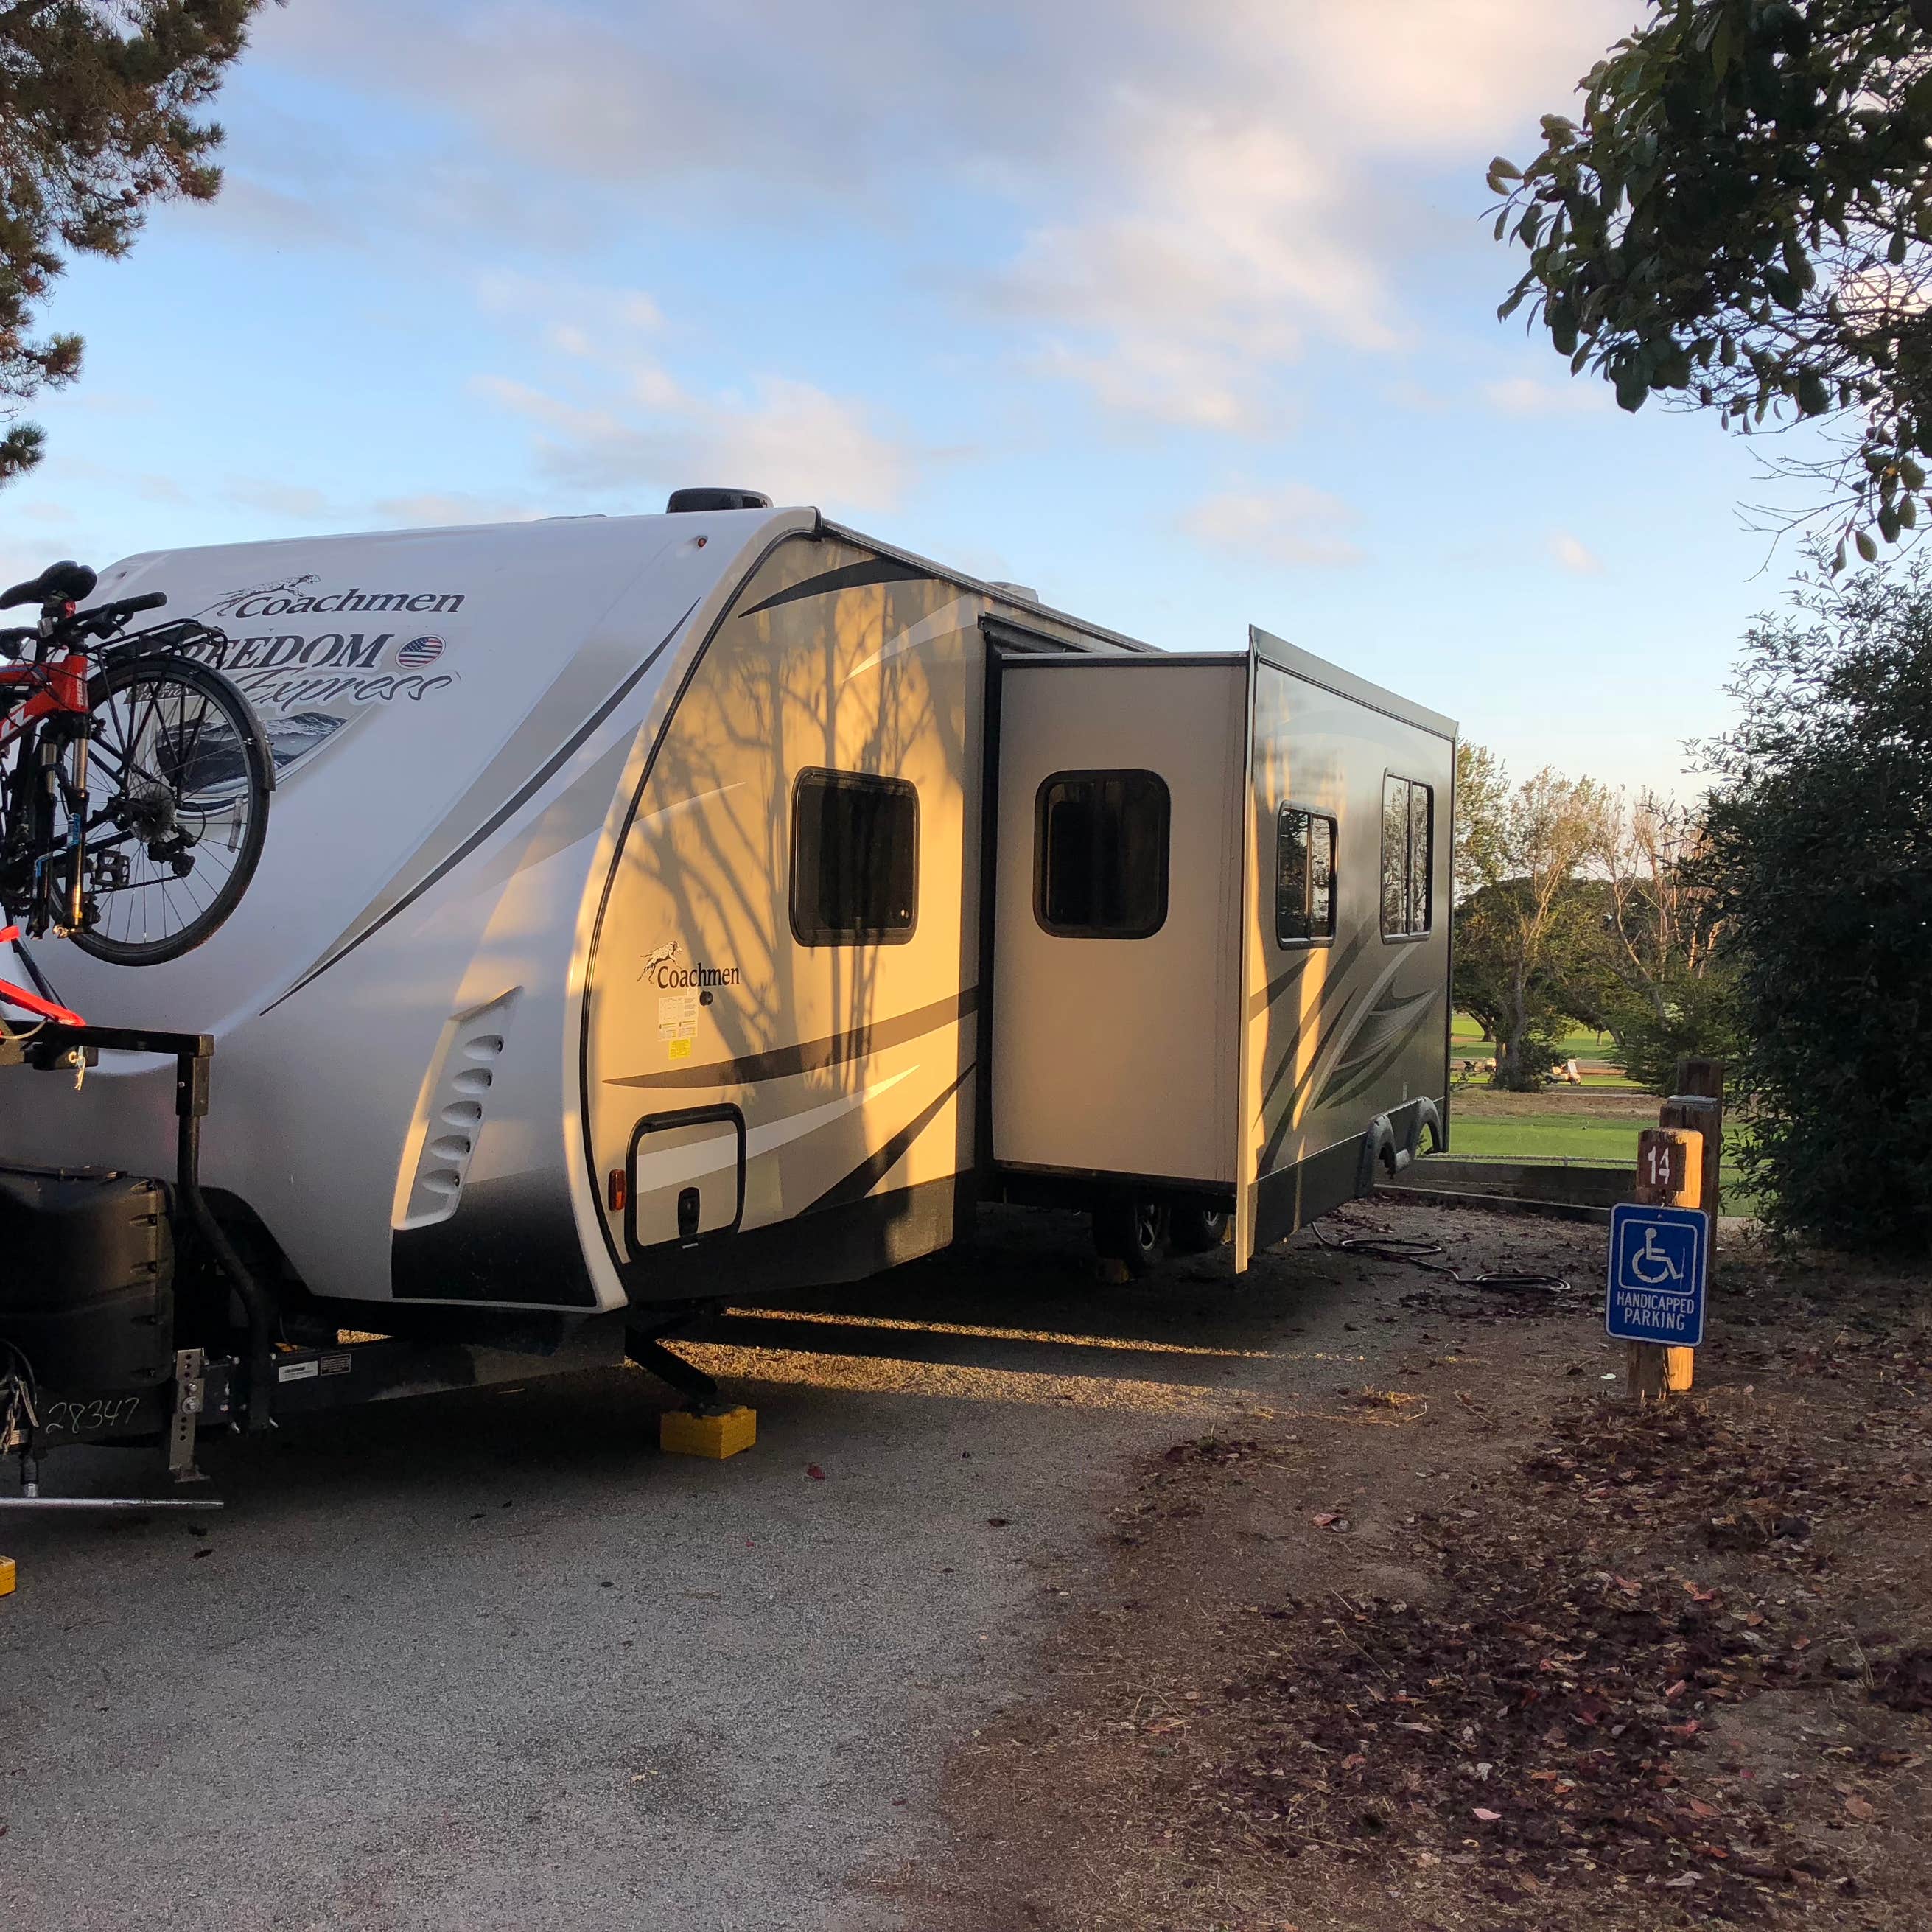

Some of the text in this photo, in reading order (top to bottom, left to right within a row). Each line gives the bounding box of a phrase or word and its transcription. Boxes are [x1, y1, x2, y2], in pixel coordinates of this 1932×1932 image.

[234, 588, 466, 619] Coachmen
[234, 666, 453, 713] Express
[657, 962, 741, 989] Coachmen
[1647, 1145, 1670, 1185] 14
[1617, 1290, 1695, 1315] HANDICAPPED
[1624, 1307, 1685, 1331] PARKING
[46, 1396, 140, 1434] 28347
